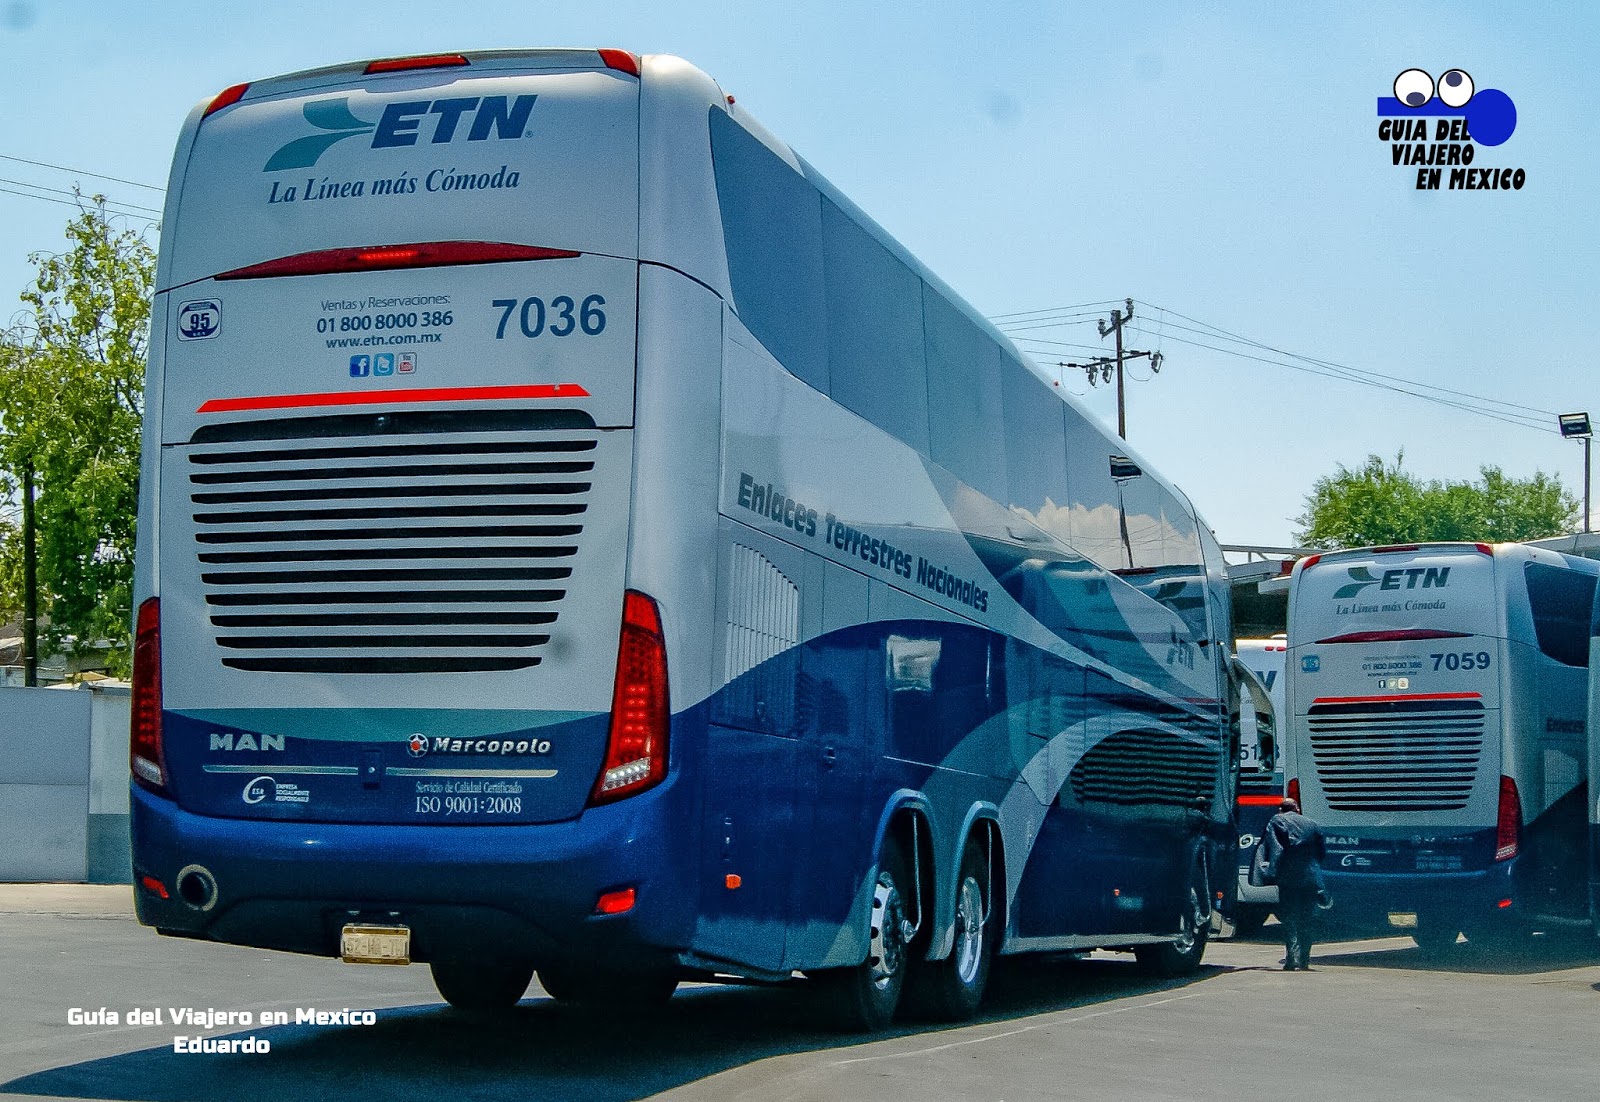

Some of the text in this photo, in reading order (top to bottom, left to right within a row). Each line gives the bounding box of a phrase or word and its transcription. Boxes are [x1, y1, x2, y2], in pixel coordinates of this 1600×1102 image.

[371, 94, 538, 148] ETN
[268, 165, 520, 204] La Línea más Cómoda
[321, 294, 451, 312] Ventas y Reservaciones:
[190, 312, 210, 331] 95
[317, 310, 453, 333] 01 800 8000 386
[492, 294, 606, 340] 7036
[325, 333, 443, 348] www.etn.com.mx
[737, 472, 989, 613] Enlaces Terrestres Nacionales
[1380, 567, 1451, 590] ETN
[1336, 604, 1349, 615] La
[1352, 603, 1379, 614] Línea
[1430, 651, 1491, 671] 7059
[209, 733, 286, 751] MAN
[433, 737, 551, 755] Marcopolo
[415, 796, 522, 816] ISO 9001:2008
